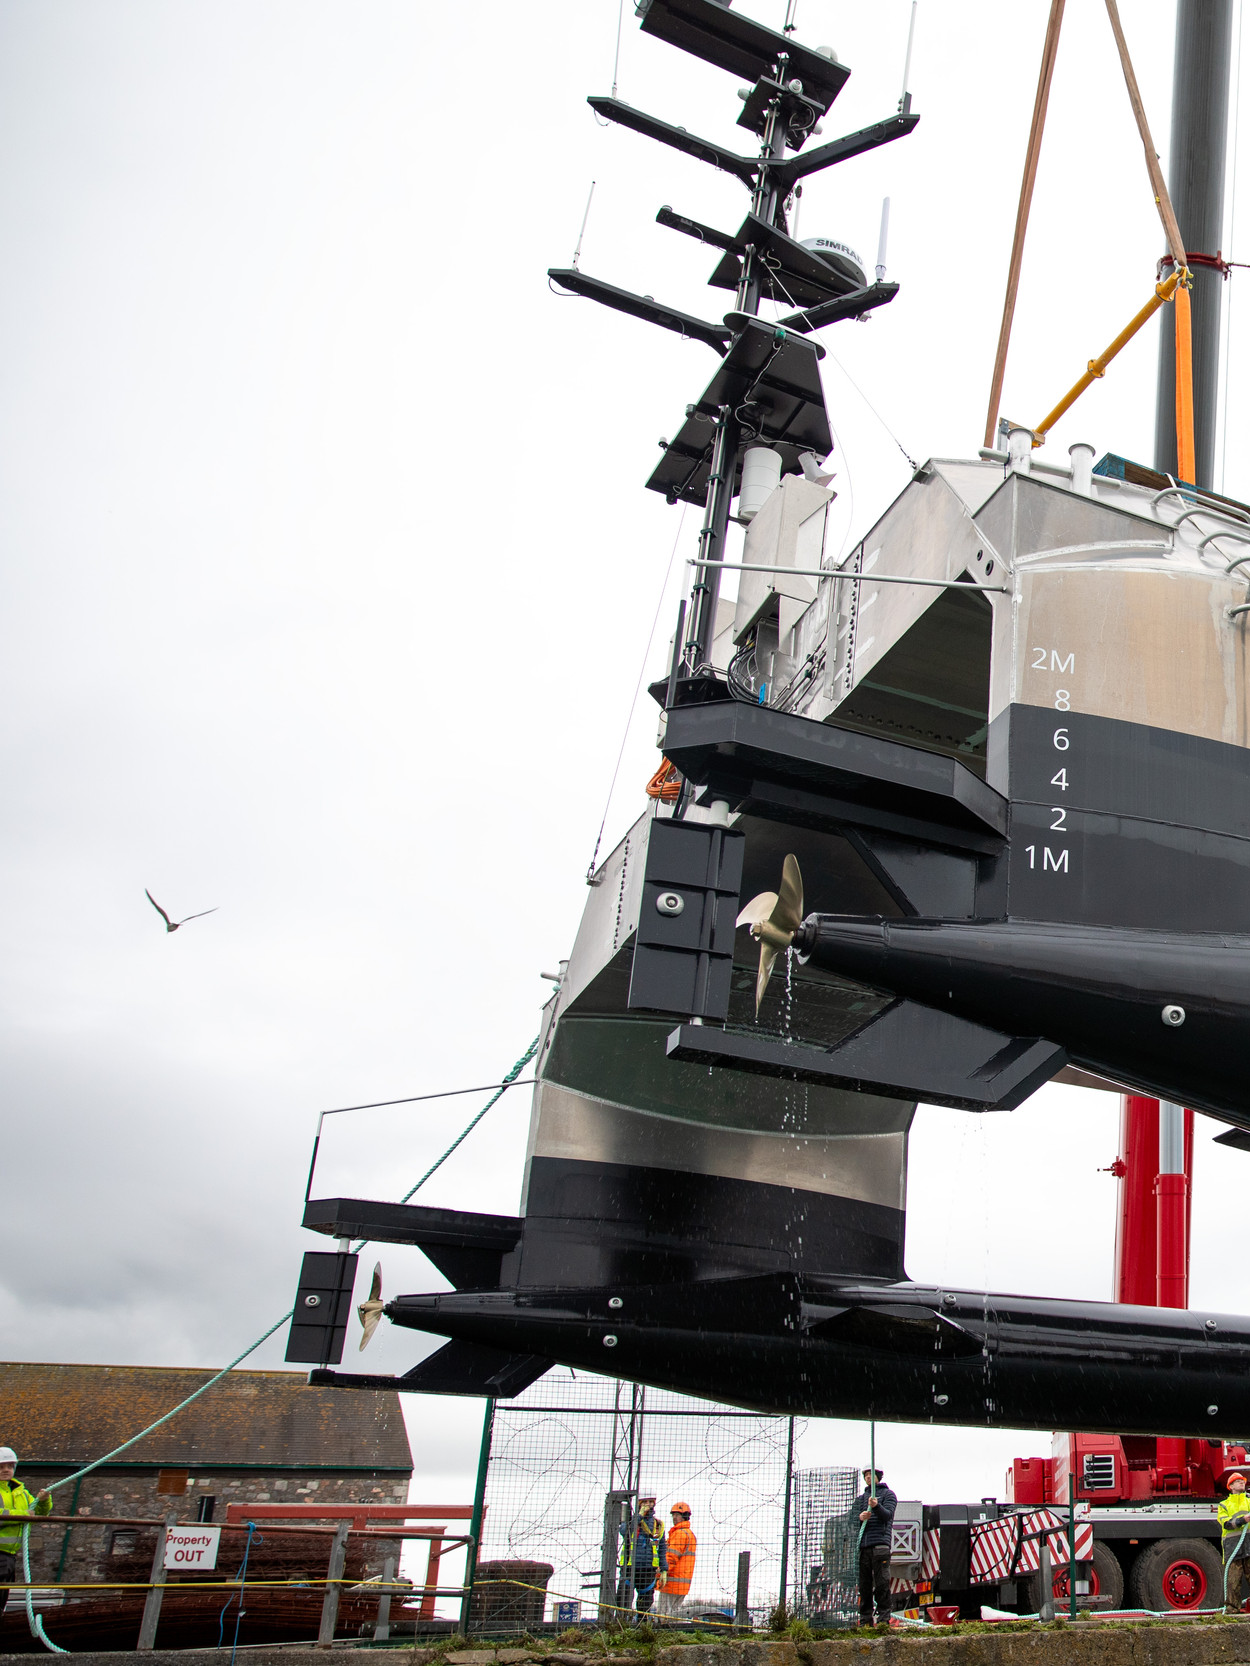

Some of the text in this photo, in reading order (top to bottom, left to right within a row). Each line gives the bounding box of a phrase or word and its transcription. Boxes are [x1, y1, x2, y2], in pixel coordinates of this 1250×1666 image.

[815, 239, 863, 265] SIMRAD
[1031, 647, 1075, 674] 2M
[1054, 689, 1071, 712] 8
[1053, 728, 1070, 751] 6
[1050, 767, 1069, 791] 4
[1050, 807, 1067, 832] 2
[1025, 845, 1069, 873] 1M
[166, 1534, 212, 1546] Property
[174, 1550, 205, 1562] OUT
